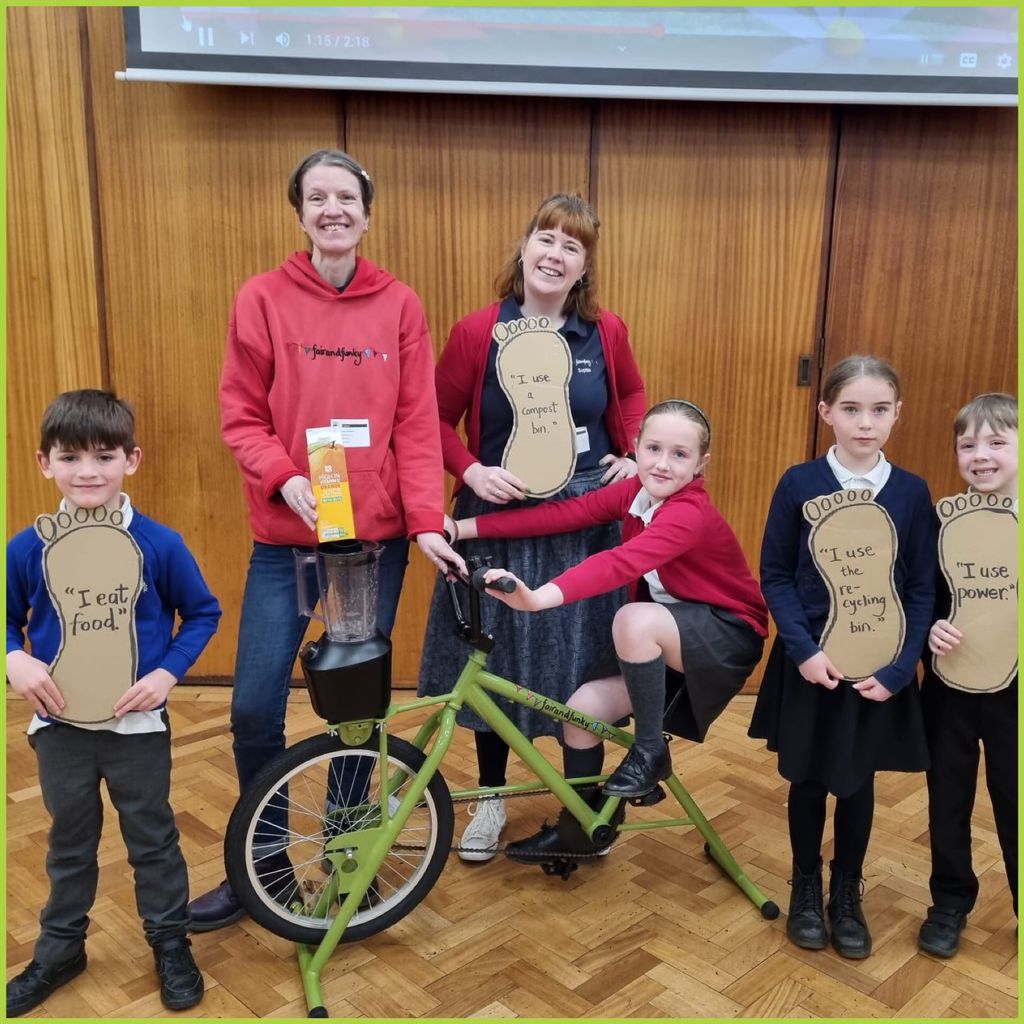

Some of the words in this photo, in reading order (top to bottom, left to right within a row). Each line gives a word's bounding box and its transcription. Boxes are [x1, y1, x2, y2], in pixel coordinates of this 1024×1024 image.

[312, 344, 362, 366] fairandfunky
[510, 374, 528, 384] "I
[532, 375, 552, 383] use
[522, 402, 558, 418] compost
[531, 421, 558, 434] bin."
[819, 546, 842, 562] "I
[846, 545, 875, 558] use
[840, 565, 864, 576] the
[956, 561, 976, 579] "I
[979, 566, 1010, 578] use
[65, 587, 91, 609] "I
[96, 584, 129, 606] eat
[839, 585, 861, 596] re-
[957, 583, 1016, 608] power."
[842, 594, 886, 617] cycling
[68, 607, 127, 636] food."
[849, 616, 885, 633] bin."
[539, 698, 590, 728] fairandfunky
